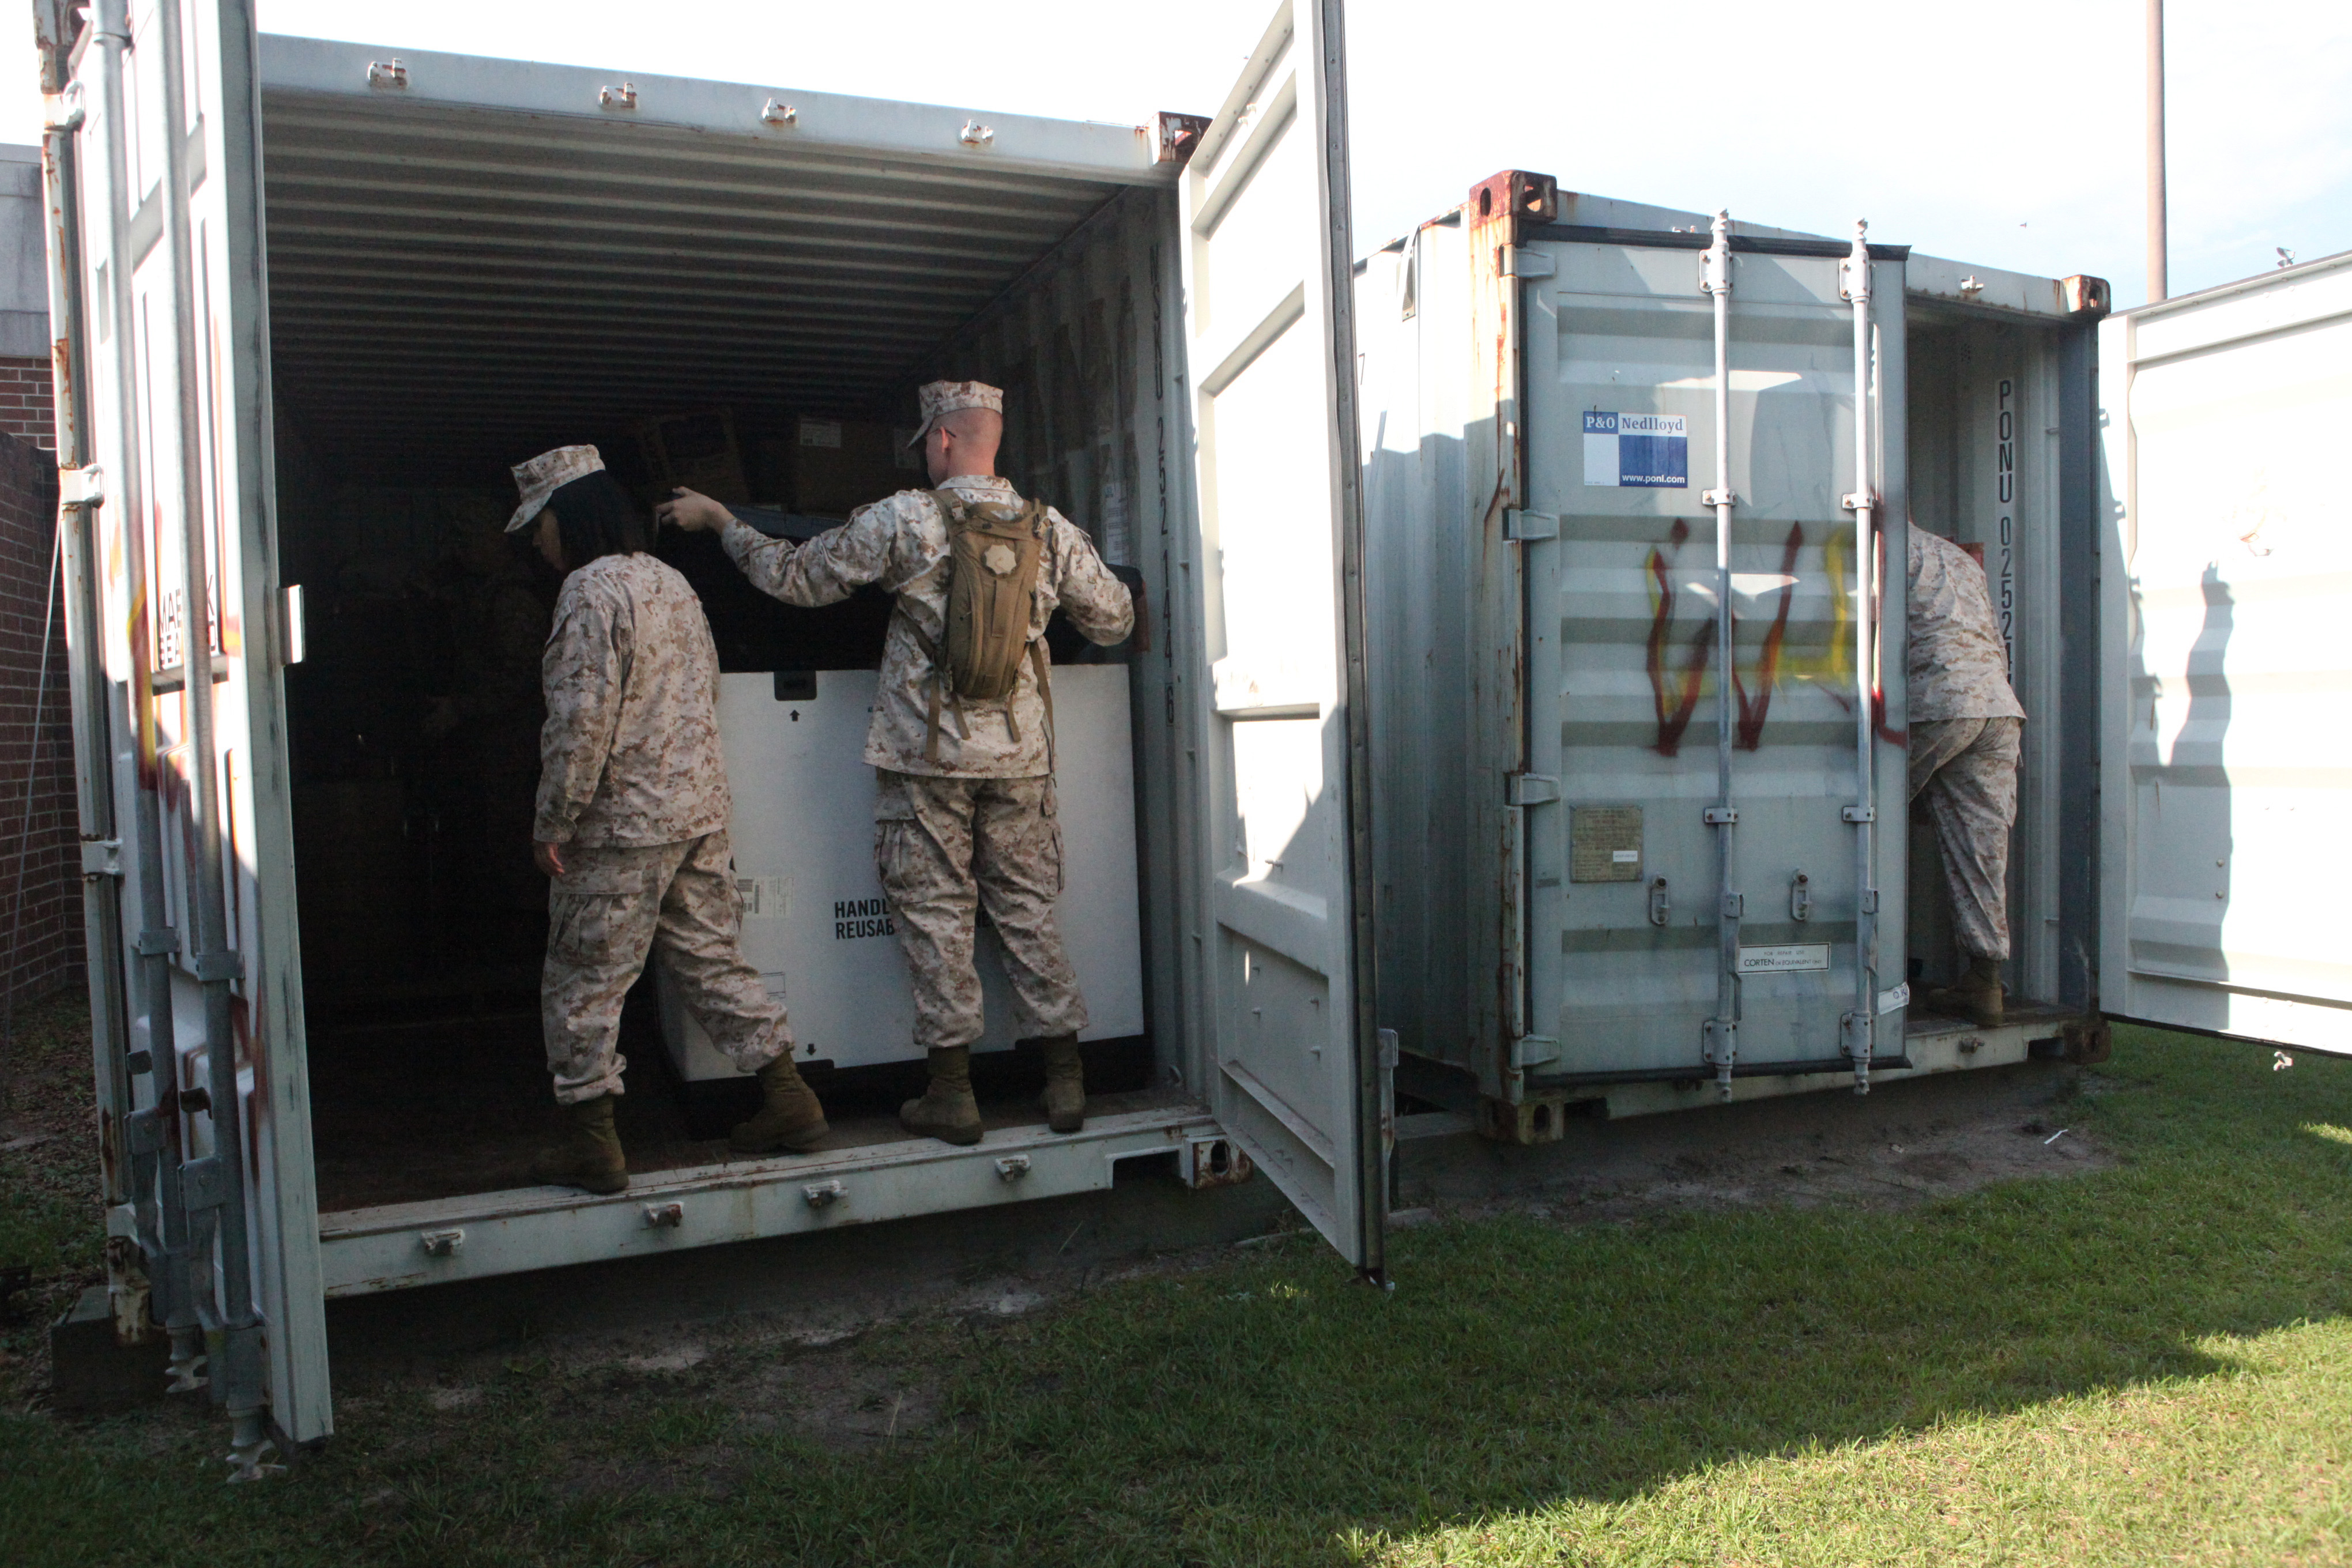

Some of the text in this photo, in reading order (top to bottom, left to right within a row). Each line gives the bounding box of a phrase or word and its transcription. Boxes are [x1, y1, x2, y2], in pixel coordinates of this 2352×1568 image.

[1586, 416, 1683, 434] P&O Nedlloyd
[1622, 474, 1685, 484] www.ponl.com
[1999, 379, 2013, 685] PONU 02524
[834, 898, 891, 919] HANDL
[835, 918, 895, 940] REUSAB
[1744, 958, 1774, 967] CORTEN
